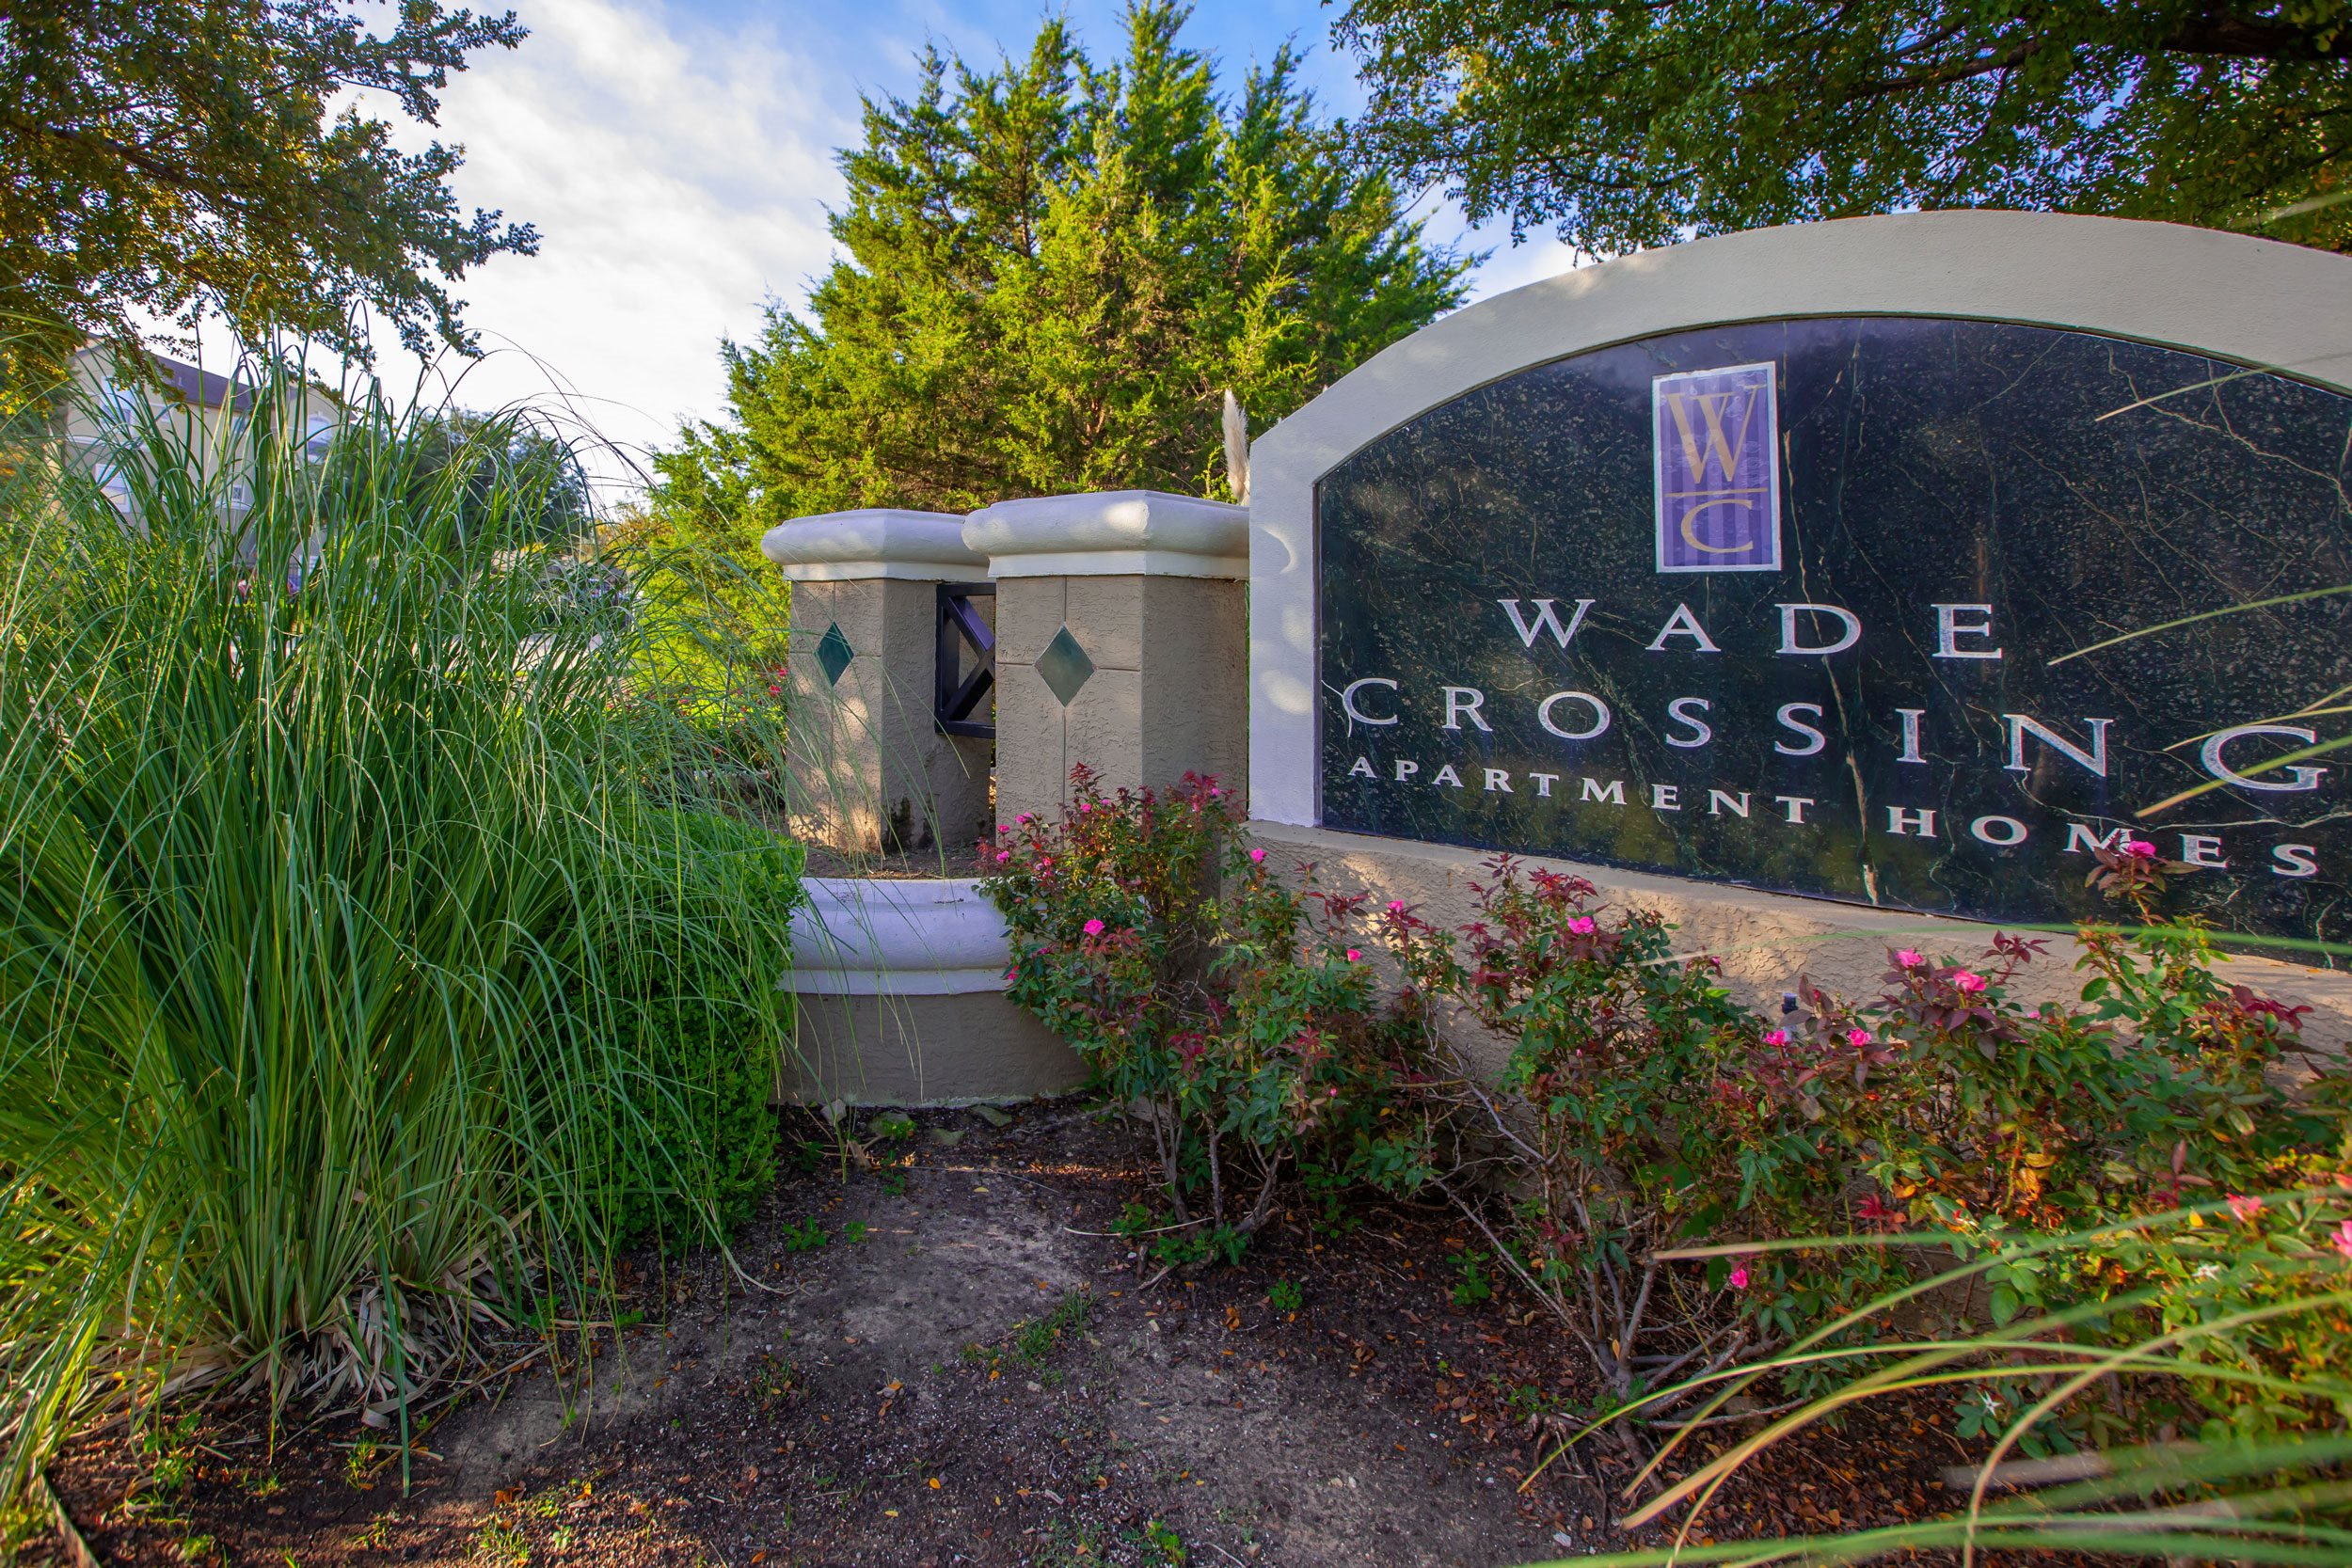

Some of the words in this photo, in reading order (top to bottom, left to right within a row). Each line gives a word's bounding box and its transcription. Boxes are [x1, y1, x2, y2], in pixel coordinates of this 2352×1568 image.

[1664, 384, 1768, 484] W
[1679, 498, 1755, 554] C
[1497, 597, 2003, 660] WADE
[1342, 676, 2329, 792] CROSSING
[1346, 755, 1815, 825] APARTMENT
[1885, 805, 2319, 878] HOMES
